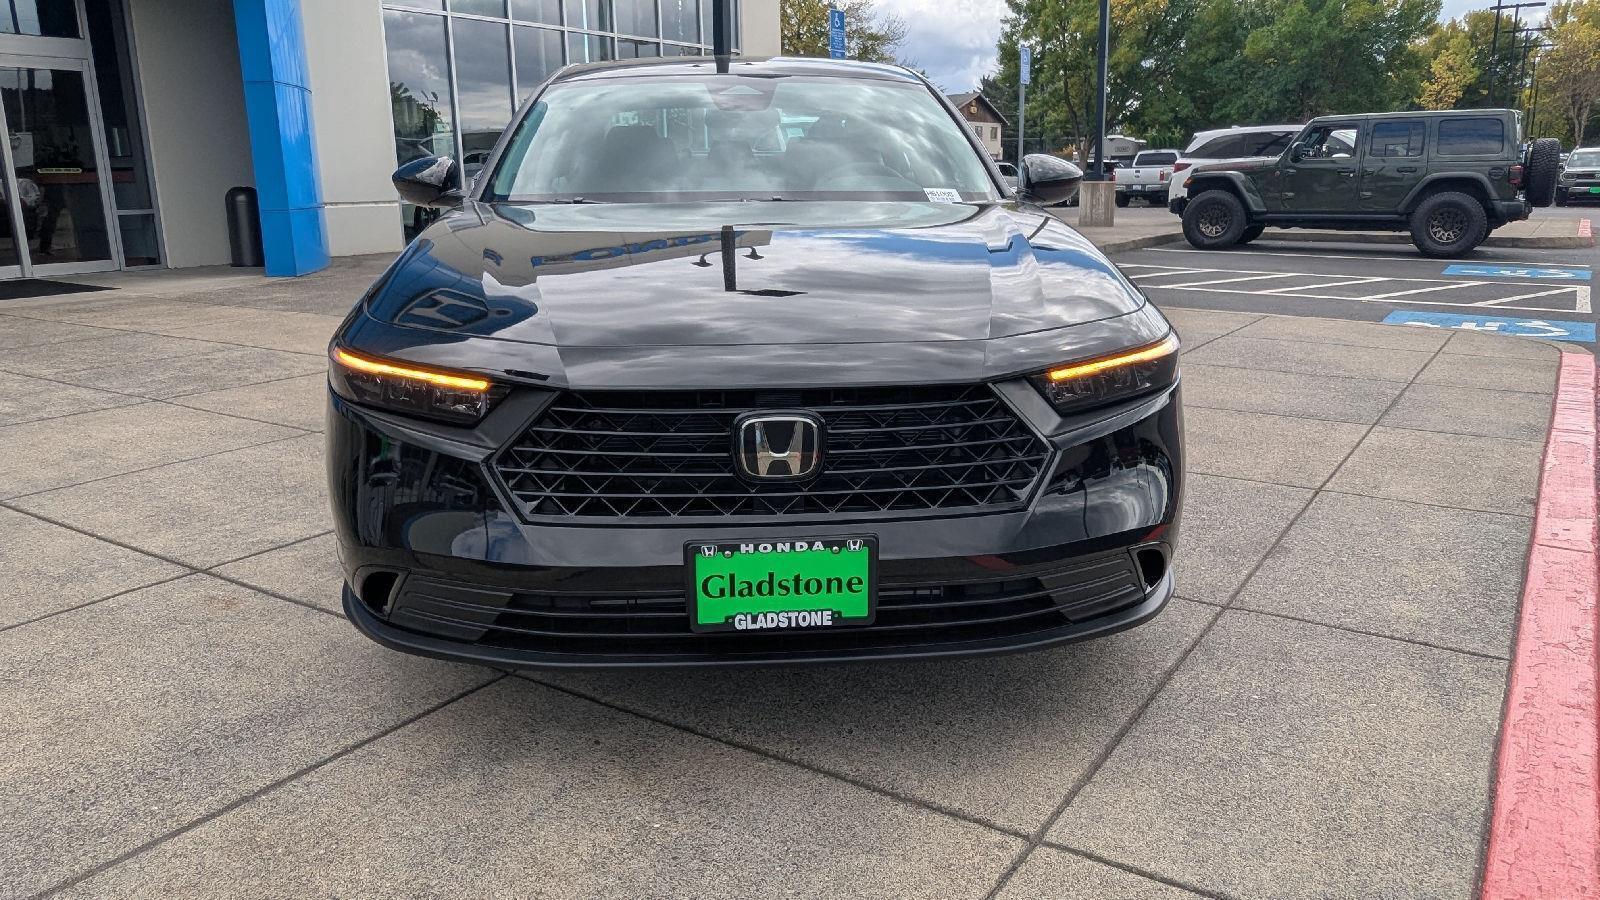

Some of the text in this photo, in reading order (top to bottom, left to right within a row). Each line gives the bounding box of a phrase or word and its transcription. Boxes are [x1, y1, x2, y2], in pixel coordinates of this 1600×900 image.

[740, 541, 825, 554] HONDA
[701, 571, 864, 599] Gladstone
[734, 610, 833, 630] GLADSTONE
